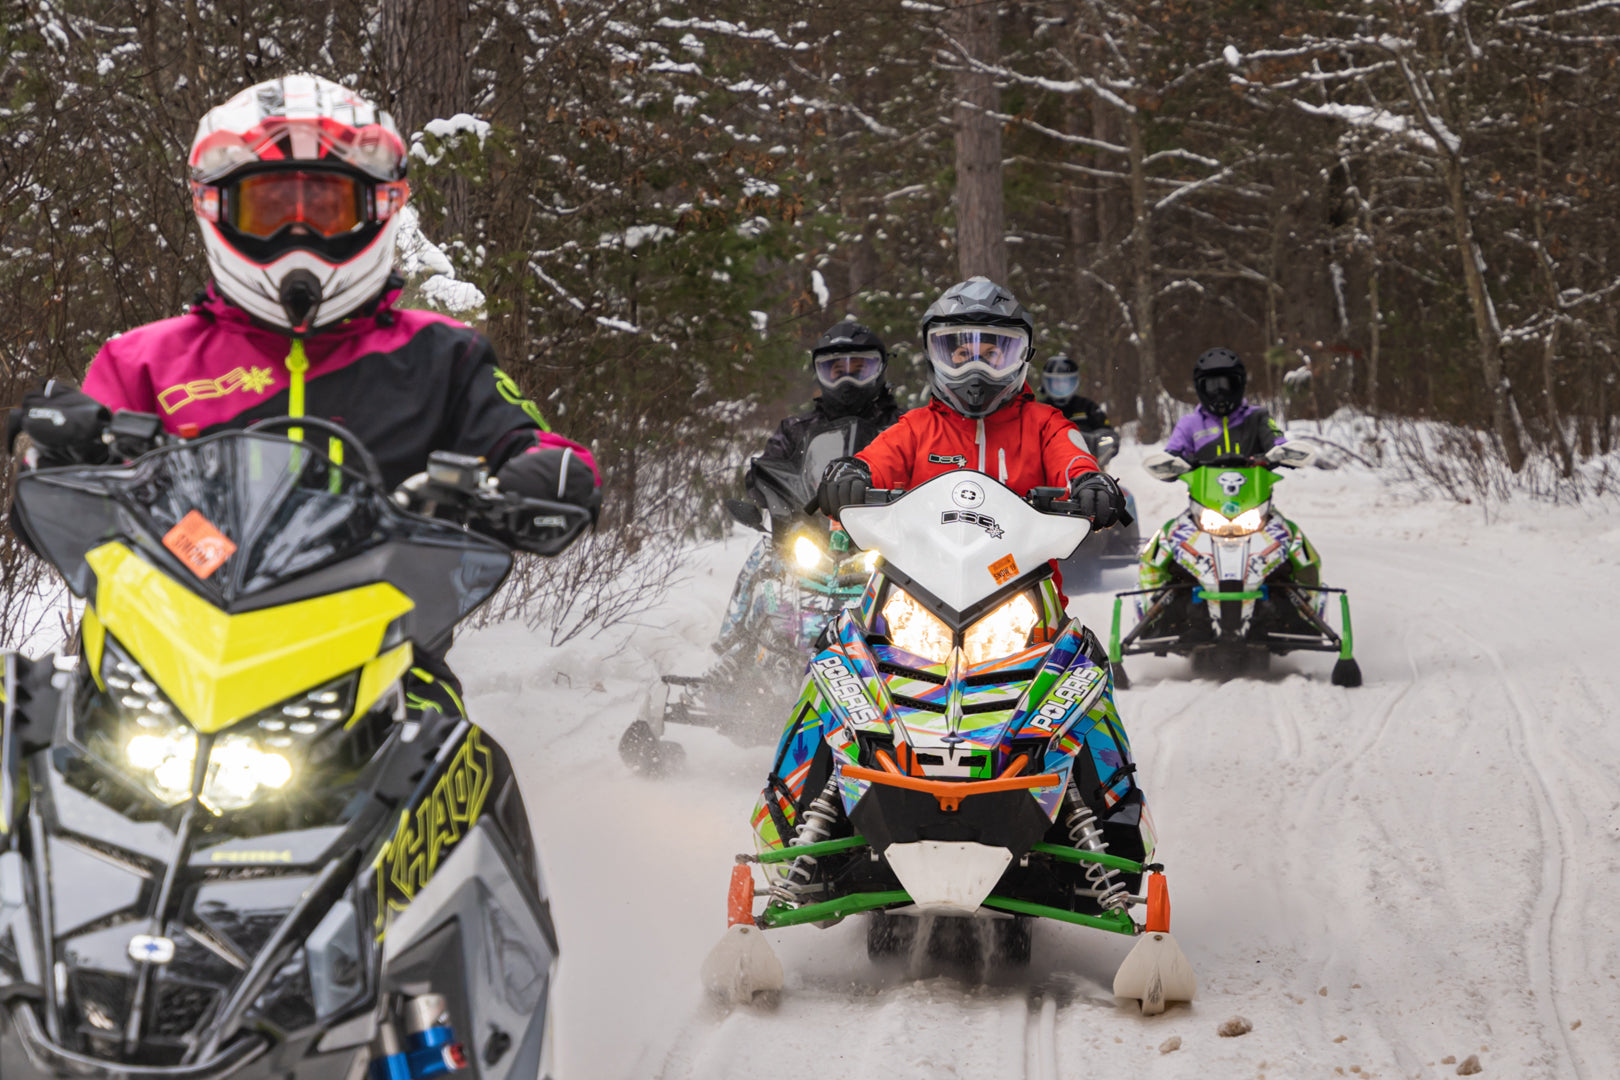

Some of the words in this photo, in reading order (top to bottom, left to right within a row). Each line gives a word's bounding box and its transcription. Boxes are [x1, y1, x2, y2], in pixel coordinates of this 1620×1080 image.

[157, 366, 245, 415] DSG
[941, 510, 995, 528] DSG
[816, 656, 879, 725] POLARIS
[1029, 666, 1099, 733] POLARIS
